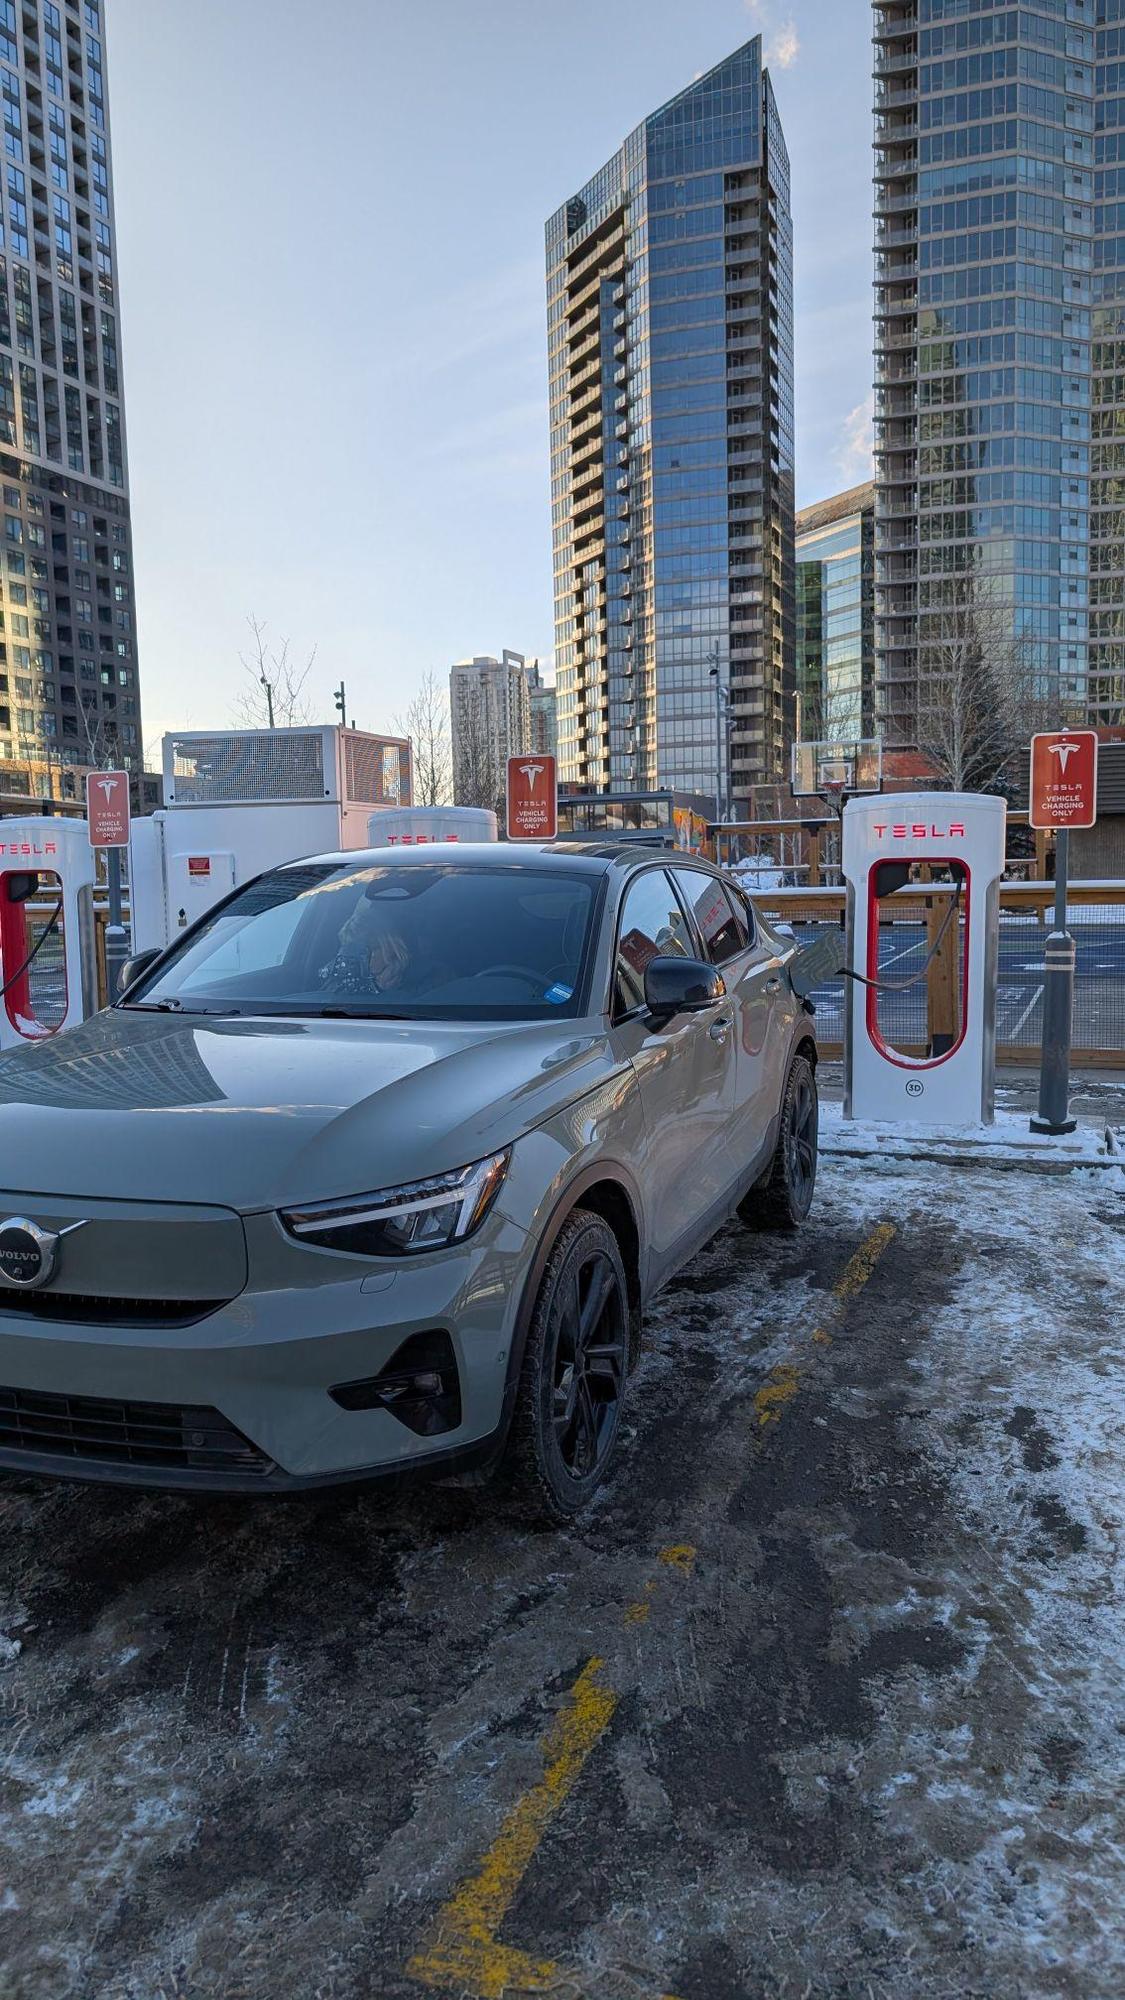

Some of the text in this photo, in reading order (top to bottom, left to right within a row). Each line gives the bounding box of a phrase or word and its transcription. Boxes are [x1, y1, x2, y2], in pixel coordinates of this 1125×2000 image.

[1044, 783, 1082, 791] TESLA
[1046, 794, 1080, 802] VEHICLE
[1041, 801, 1084, 810] CHARGING
[1051, 809, 1074, 817] ONLY
[515, 816, 548, 824] CHARGING
[873, 824, 964, 839] TESLA
[0, 842, 56, 855] TESLA
[909, 1083, 921, 1092] 3D
[0, 1249, 40, 1261] VOLVO
